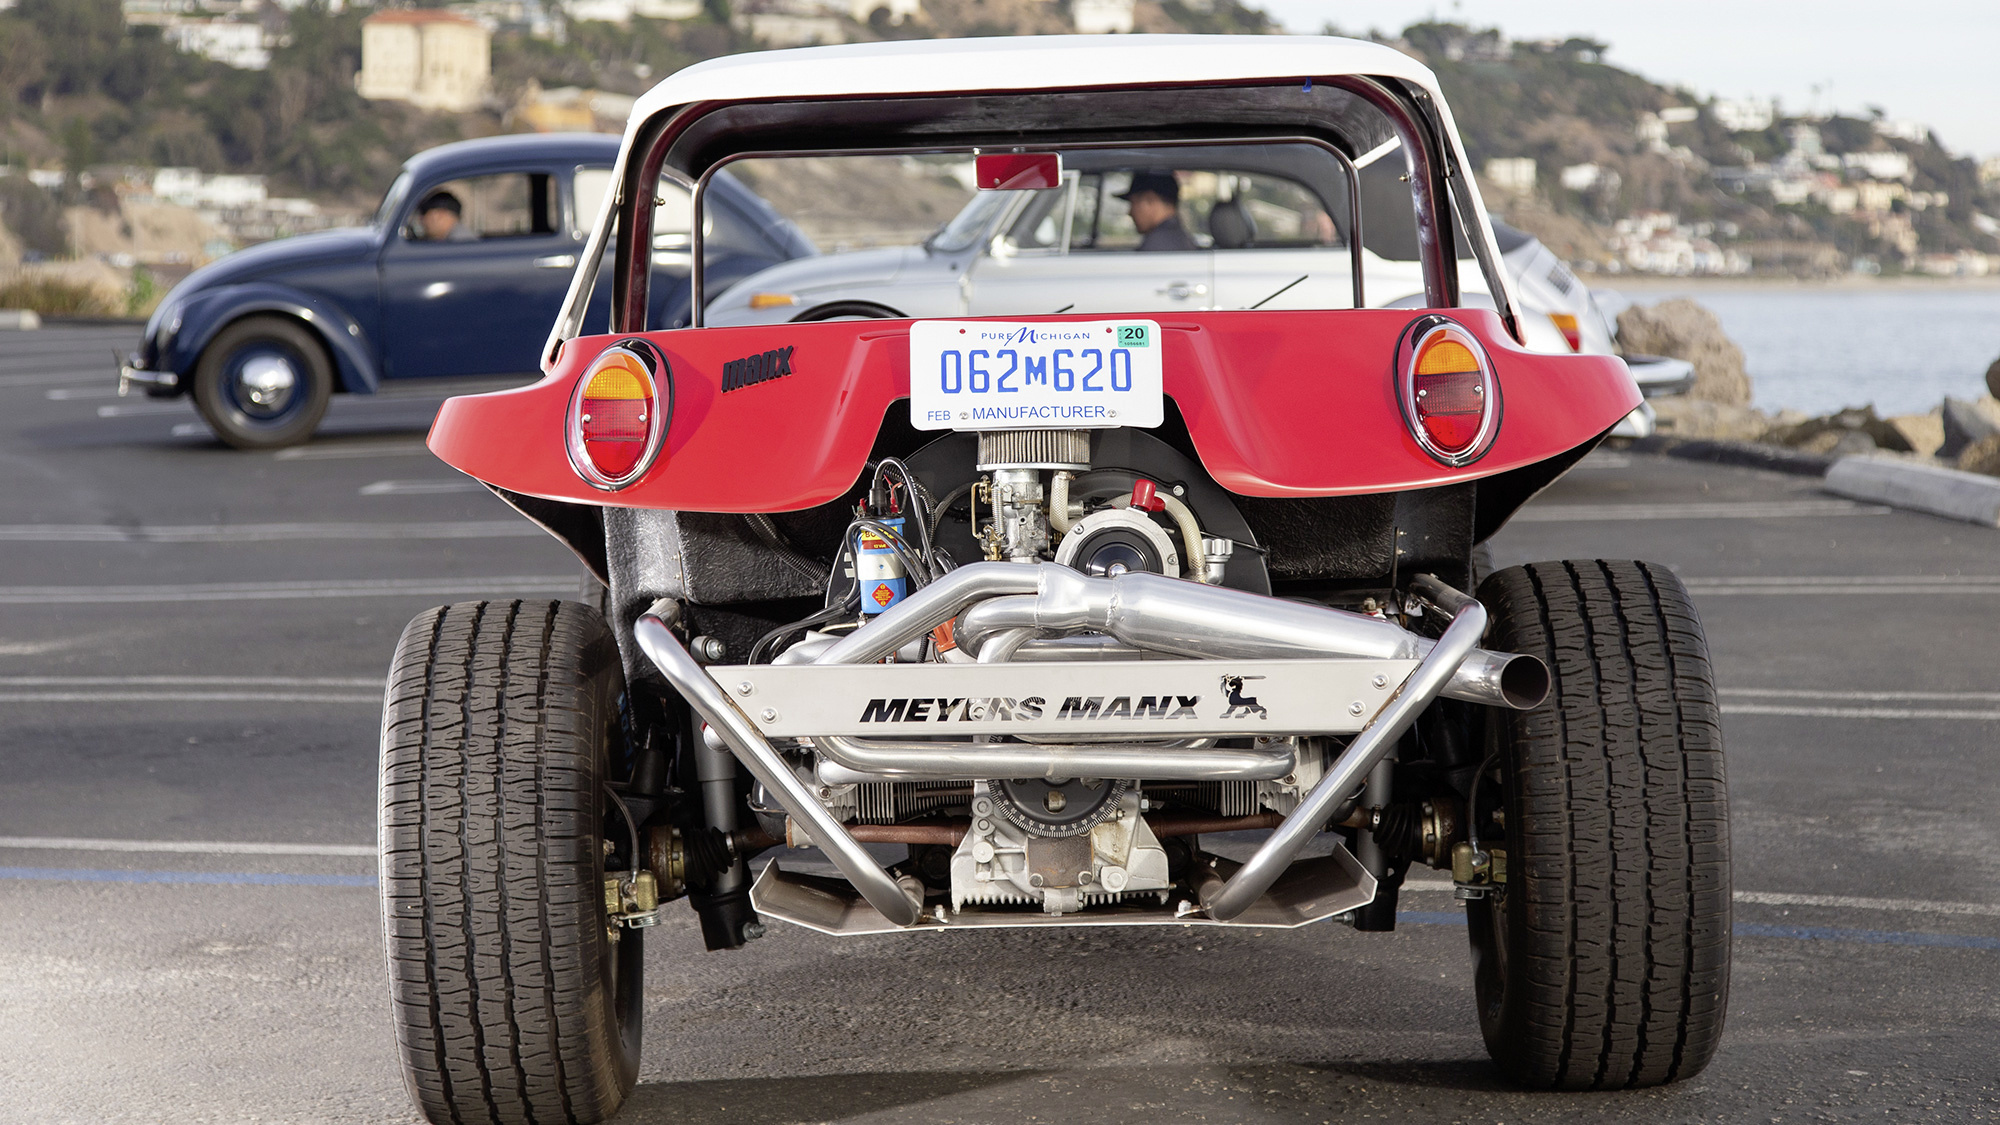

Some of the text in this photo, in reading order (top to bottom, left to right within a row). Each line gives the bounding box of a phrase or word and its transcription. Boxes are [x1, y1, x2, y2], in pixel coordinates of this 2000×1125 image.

[981, 326, 1090, 346] PURE MICHIGAN
[1124, 327, 1144, 339] 20
[940, 348, 1132, 394] 062M620
[927, 405, 1106, 421] FEB MANUFACTURER
[859, 695, 1204, 722] MEYERS MANX
